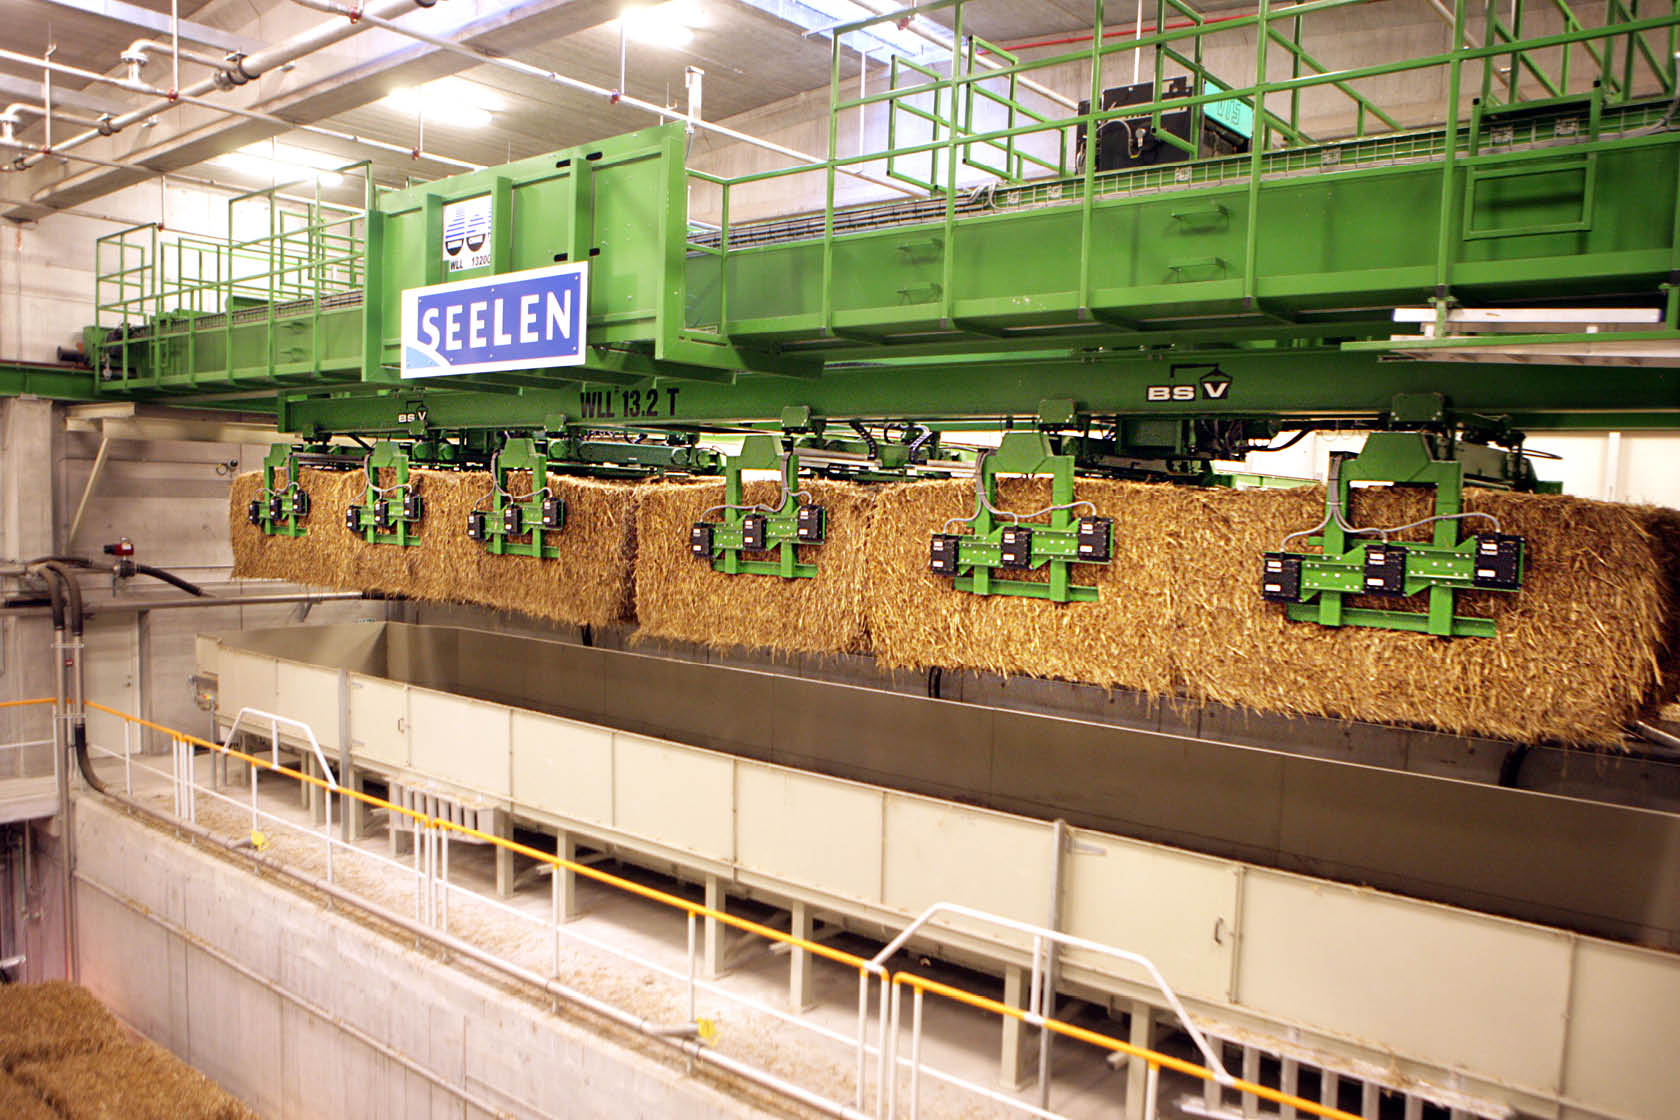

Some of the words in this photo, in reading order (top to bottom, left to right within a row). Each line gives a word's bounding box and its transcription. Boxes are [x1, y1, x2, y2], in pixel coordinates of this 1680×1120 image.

[450, 259, 463, 271] WLL
[422, 289, 572, 351] SEELEN
[580, 391, 615, 418] WLL
[622, 389, 659, 417] 13.2
[667, 387, 680, 417] T
